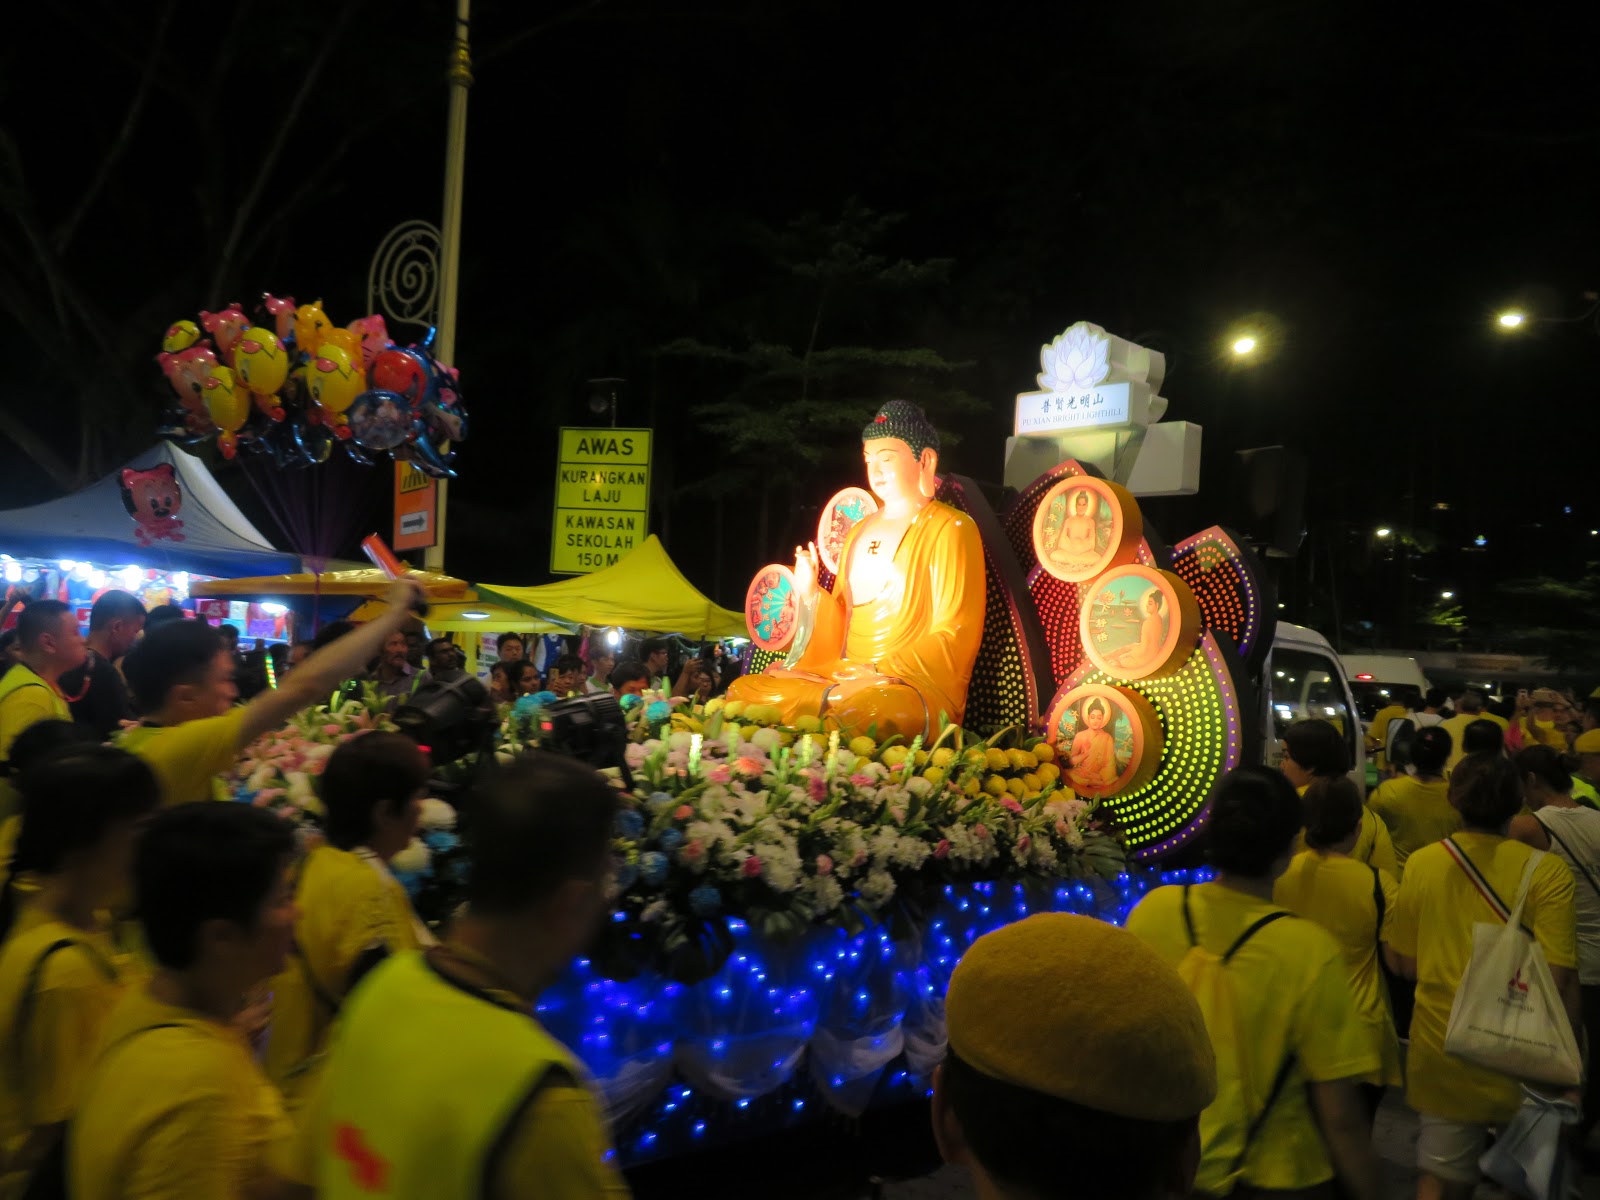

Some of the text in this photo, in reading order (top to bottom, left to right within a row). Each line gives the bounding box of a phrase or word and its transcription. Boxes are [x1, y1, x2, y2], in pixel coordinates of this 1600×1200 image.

[1033, 416, 1050, 425] XIAN
[1052, 412, 1080, 423] BRIGHT
[1082, 407, 1122, 420] LIGHTHILL
[576, 438, 634, 456] AWAS
[562, 470, 645, 485] KURANGKAN
[583, 489, 621, 503] LAJU
[566, 515, 635, 531] KAWASAN
[566, 533, 634, 549] SEKOLAH
[577, 553, 619, 567] 150 M
